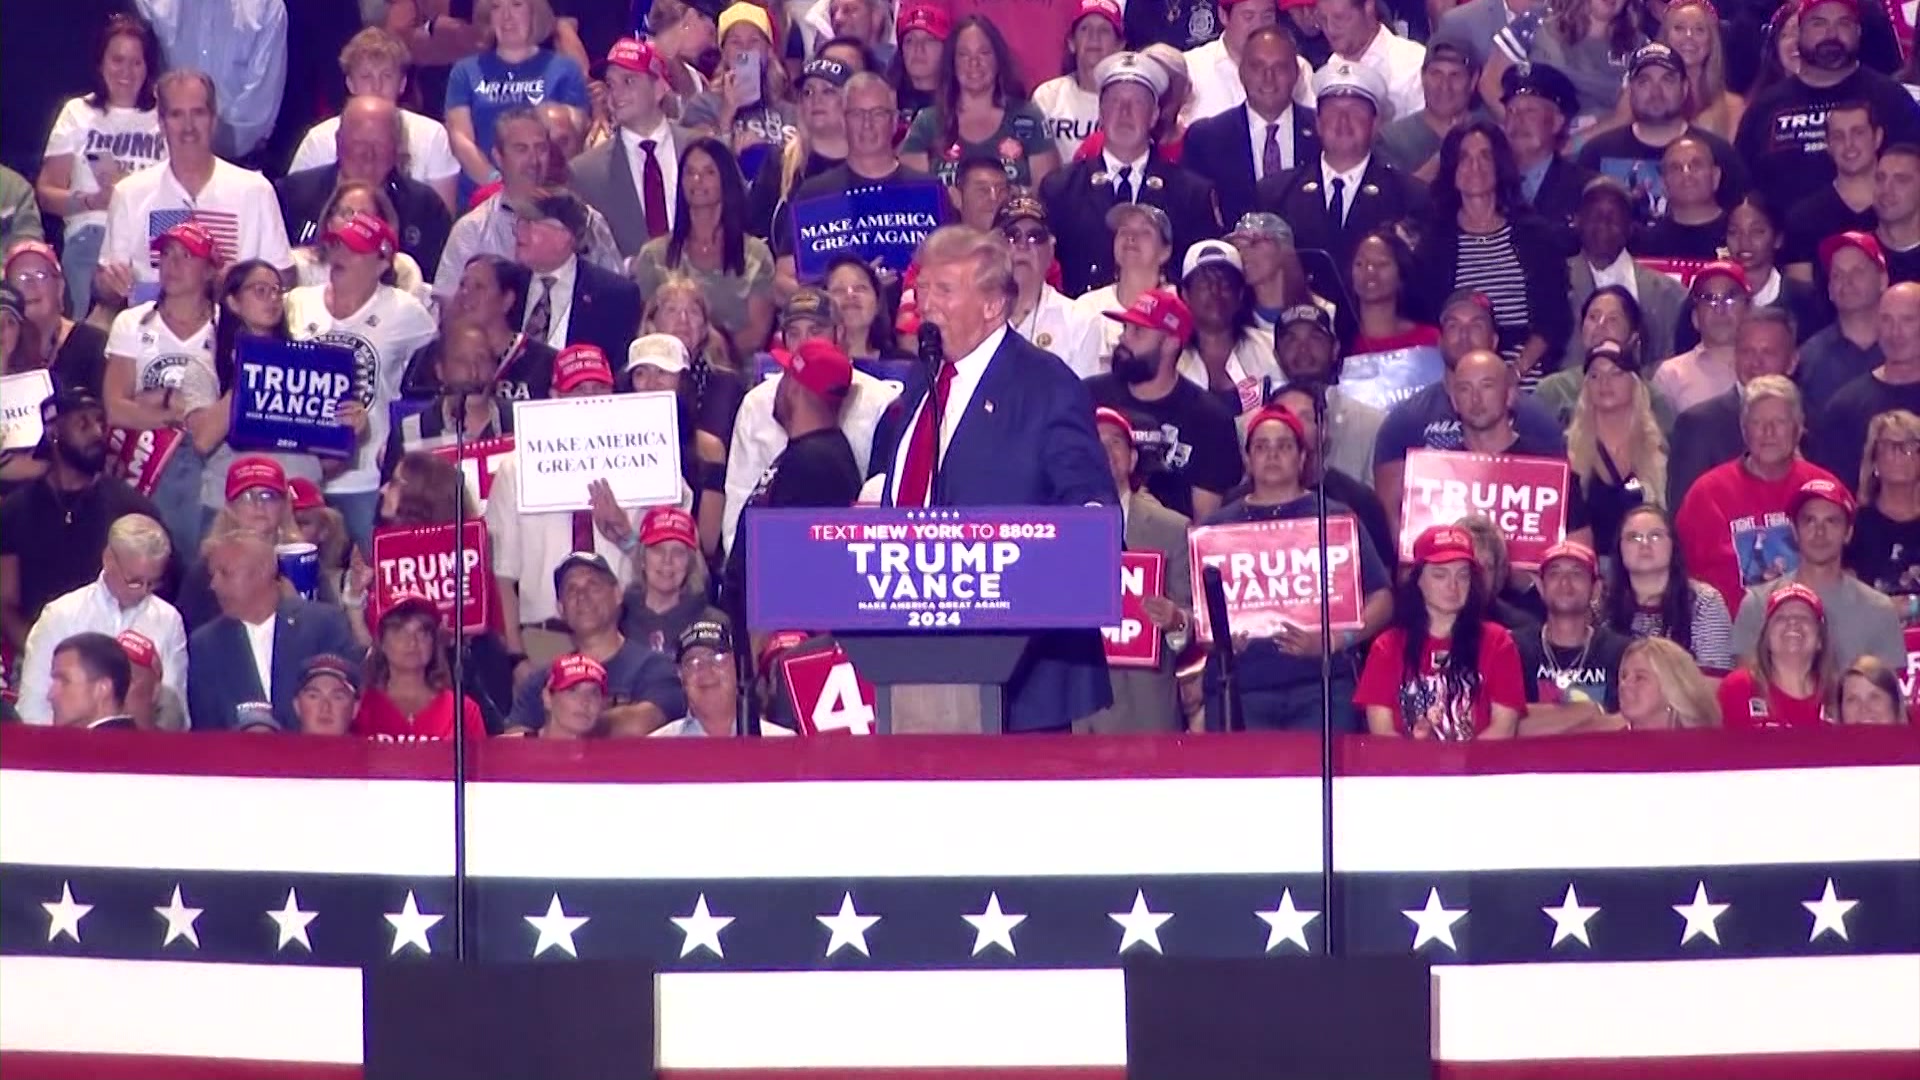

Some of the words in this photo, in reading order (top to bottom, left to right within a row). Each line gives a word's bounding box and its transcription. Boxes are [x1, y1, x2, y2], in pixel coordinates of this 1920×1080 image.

[801, 218, 853, 240] MAKE
[855, 212, 938, 231] AMERICA
[811, 231, 871, 252] GREAT
[243, 362, 351, 398] TRUMP
[254, 390, 341, 418] VANCE
[526, 437, 583, 456] MAKE
[583, 431, 668, 450] AMERICA
[538, 453, 598, 474] GREAT
[604, 451, 660, 471] AGAIN
[1416, 482, 1560, 512] TRUMP
[814, 526, 858, 540] TEXT
[862, 526, 907, 540] NEW
[913, 525, 965, 540] YORK
[970, 525, 996, 540] TO
[1000, 524, 1057, 540] 88022
[380, 549, 480, 588] TRUMP
[847, 542, 1021, 572] TRUMP
[1201, 545, 1350, 580] TRUMP
[866, 573, 1002, 600] VANCE
[1221, 573, 1337, 601] VANCE
[889, 601, 937, 610] AMERICA
[907, 611, 961, 627] 2024
[811, 662, 875, 736] 4
